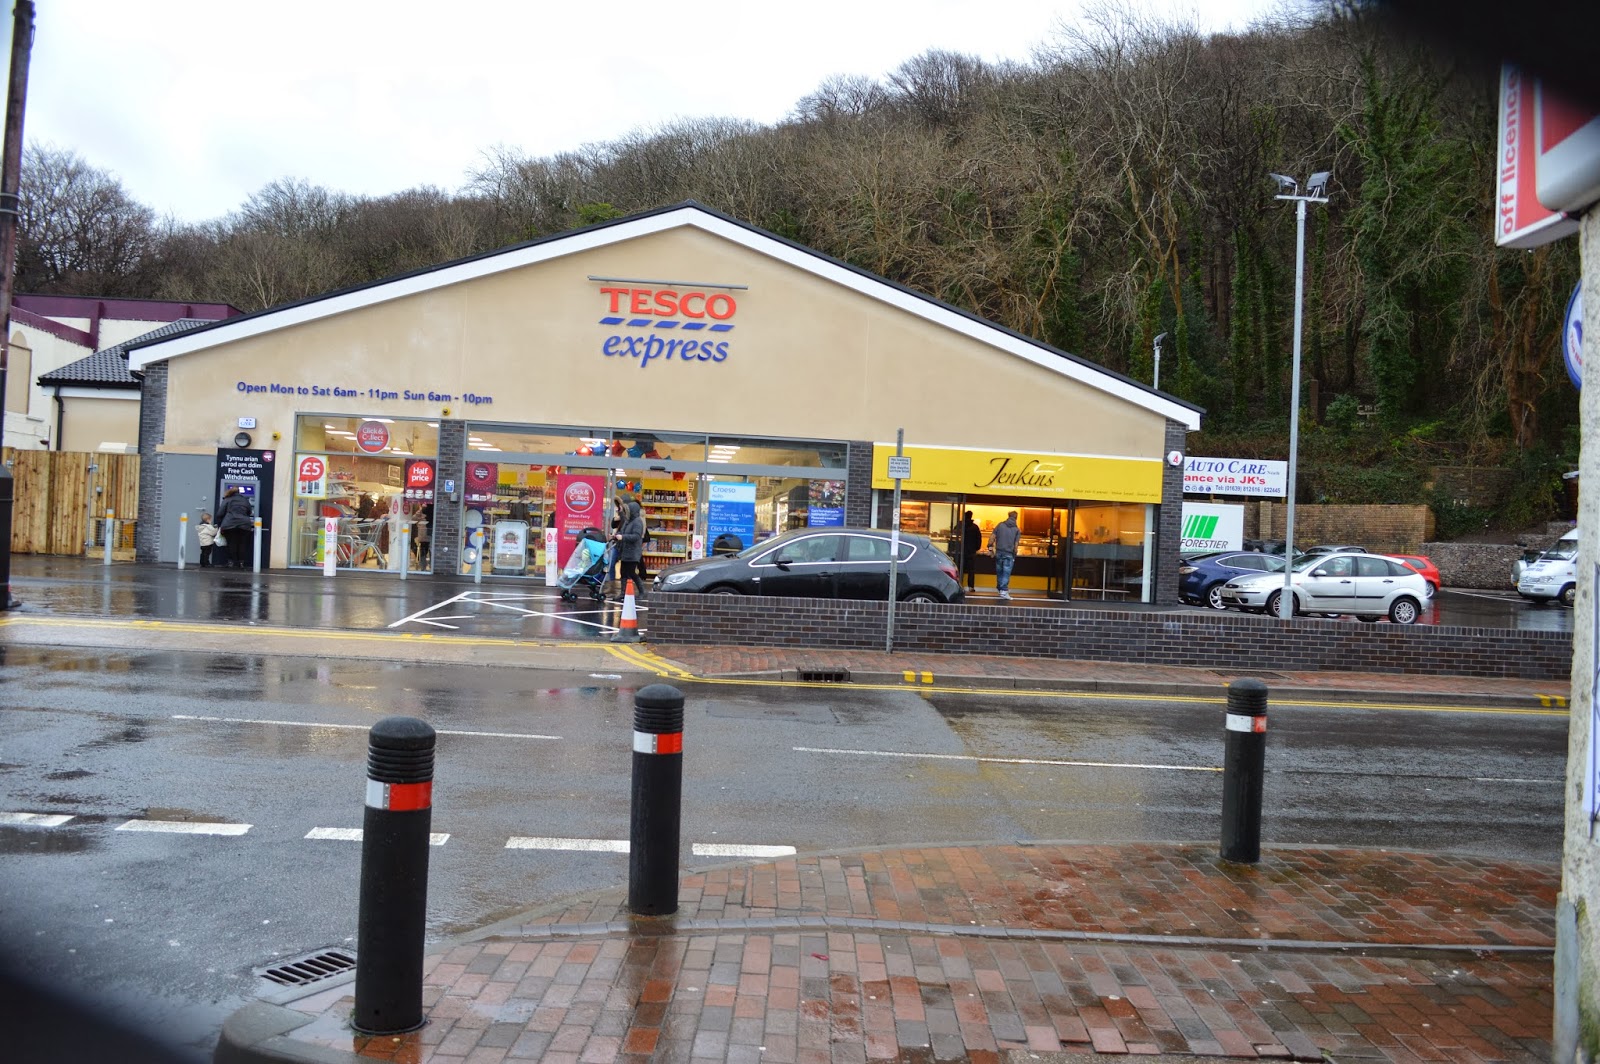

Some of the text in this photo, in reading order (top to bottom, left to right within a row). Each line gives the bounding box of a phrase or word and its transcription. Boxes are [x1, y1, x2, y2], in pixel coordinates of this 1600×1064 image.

[1501, 193, 1514, 234] off
[600, 287, 737, 320] TESCO
[603, 334, 729, 368] express
[237, 381, 267, 394] Open
[270, 383, 294, 394] Mon
[297, 385, 309, 395] to
[312, 386, 330, 396] Sat
[333, 387, 357, 397] 6am
[368, 388, 398, 400] 11pm
[403, 390, 425, 401] Sun
[428, 391, 451, 402] 6am
[462, 393, 492, 405] 10pm
[226, 454, 243, 462] Tynnu
[301, 462, 320, 476] £5
[413, 467, 428, 475] Half
[974, 457, 1055, 488] Jenkins
[1185, 459, 1267, 475] AUTO CARE
[1184, 475, 1266, 485] ance via JK's
[712, 486, 736, 494] Croeso
[1181, 538, 1228, 549] FORESTIER
